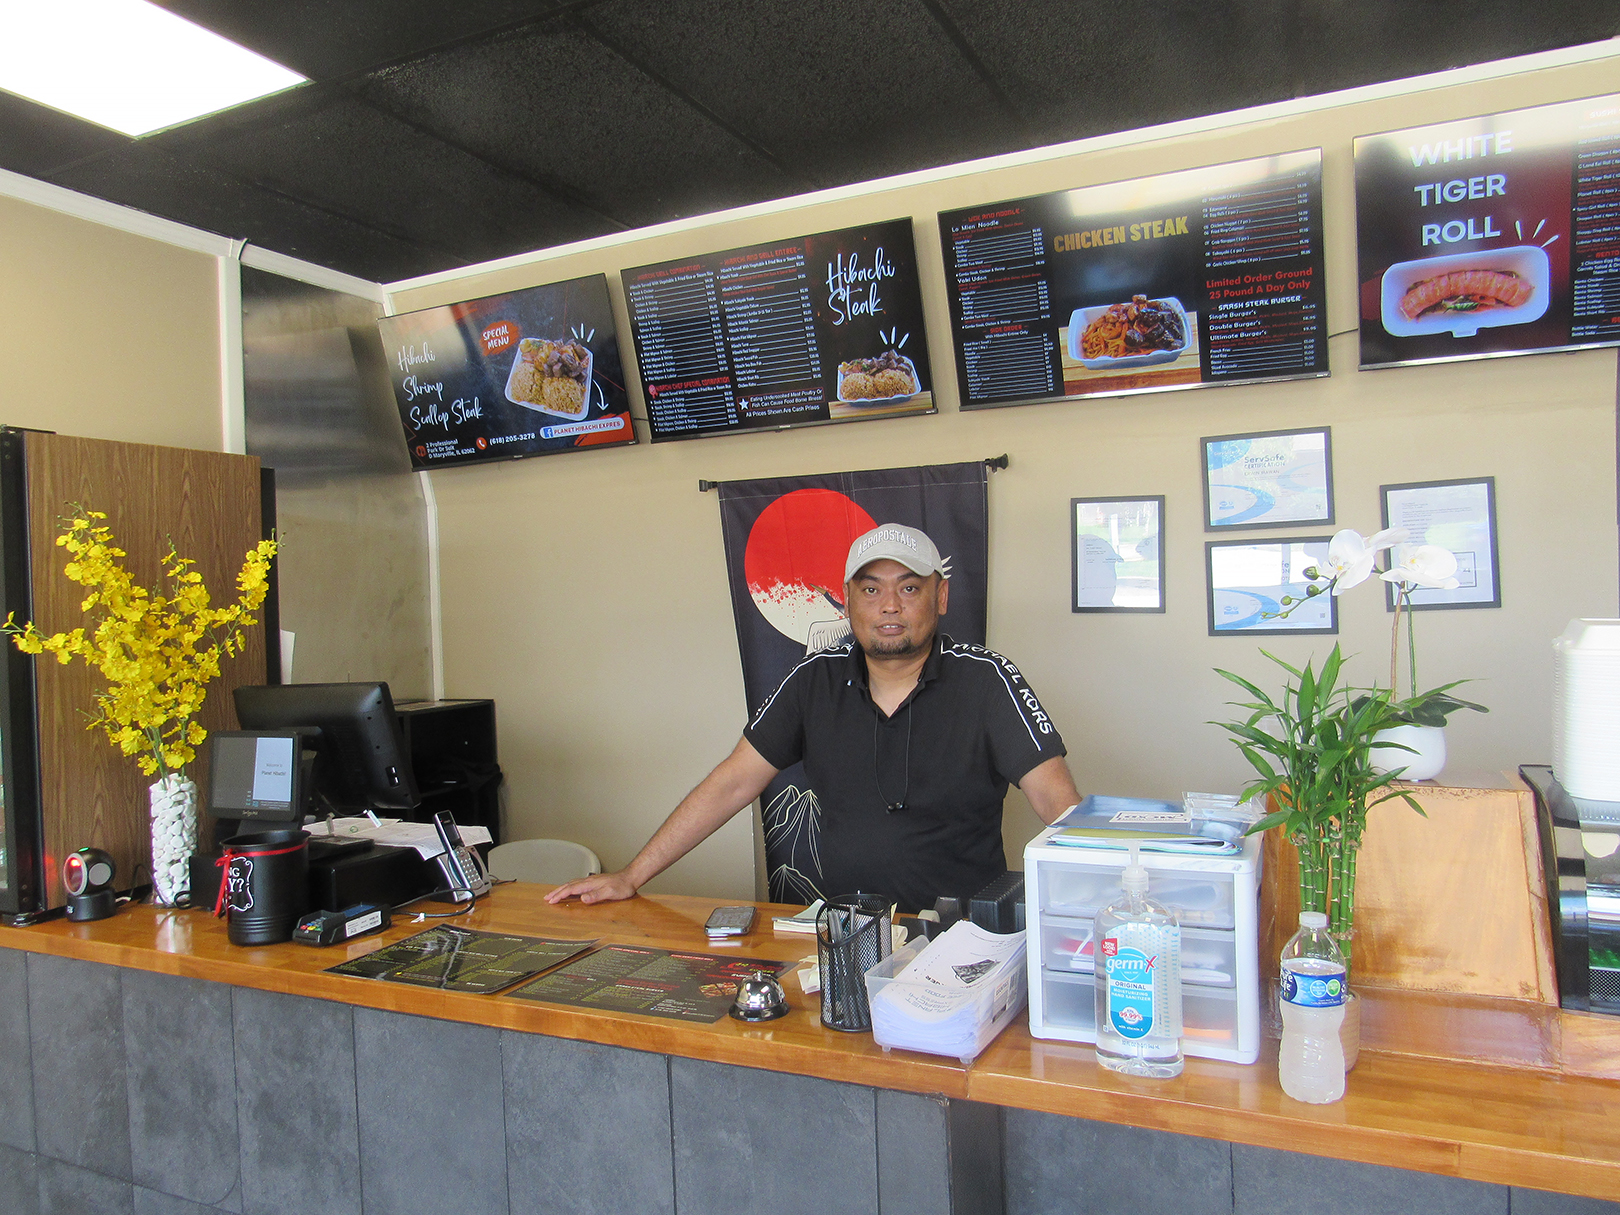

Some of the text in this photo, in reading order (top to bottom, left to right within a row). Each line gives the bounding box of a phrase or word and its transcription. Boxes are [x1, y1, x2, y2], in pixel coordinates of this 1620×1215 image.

[1408, 130, 1513, 168] WHITE
[1414, 174, 1506, 206] TIGER
[978, 220, 999, 228] Noodle
[1054, 227, 1126, 252] CHICKEN
[1130, 216, 1189, 242] STEAK
[1422, 216, 1501, 246] ROLL
[826, 247, 896, 292] Hibachi
[1206, 267, 1312, 288] Limited Order Ground
[1209, 280, 1310, 300] 25 Pound A Day Only
[828, 282, 883, 326] Steak
[1218, 302, 1244, 312] SMASH
[1270, 295, 1302, 306] BURGER
[1208, 312, 1228, 320] Single
[482, 324, 510, 340] SPECIAL
[1210, 332, 1238, 341] Ultimate
[487, 336, 510, 350] MENU
[398, 342, 436, 373] Hibachi
[402, 376, 443, 402] Shrimp
[409, 397, 484, 431] Scallop Steak
[430, 438, 458, 448] Professional
[490, 436, 504, 446] (618)
[1019, 688, 1053, 734] KORS
[1114, 980, 1146, 990] ORIGINAL
